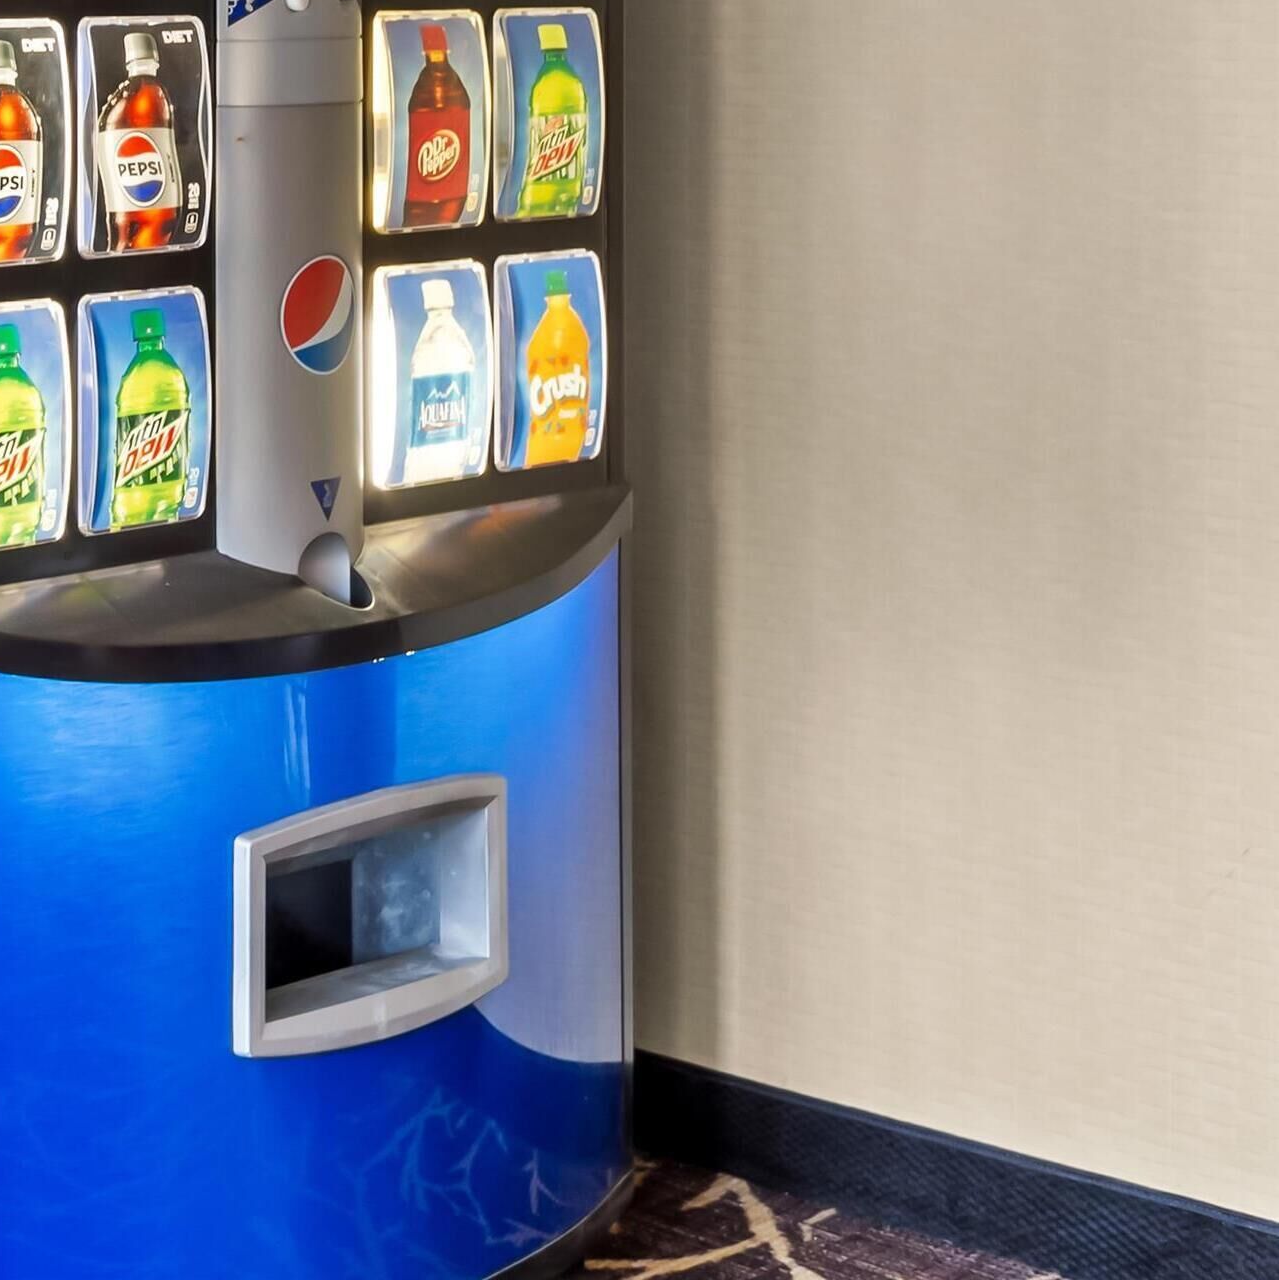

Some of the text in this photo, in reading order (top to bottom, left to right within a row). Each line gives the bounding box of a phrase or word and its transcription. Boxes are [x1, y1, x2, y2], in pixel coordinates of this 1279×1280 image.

[21, 36, 55, 53] DIET
[161, 29, 194, 44] DIET
[117, 160, 163, 177] PEPSI
[530, 364, 586, 416] Crush
[419, 396, 467, 430] AQUAFINA
